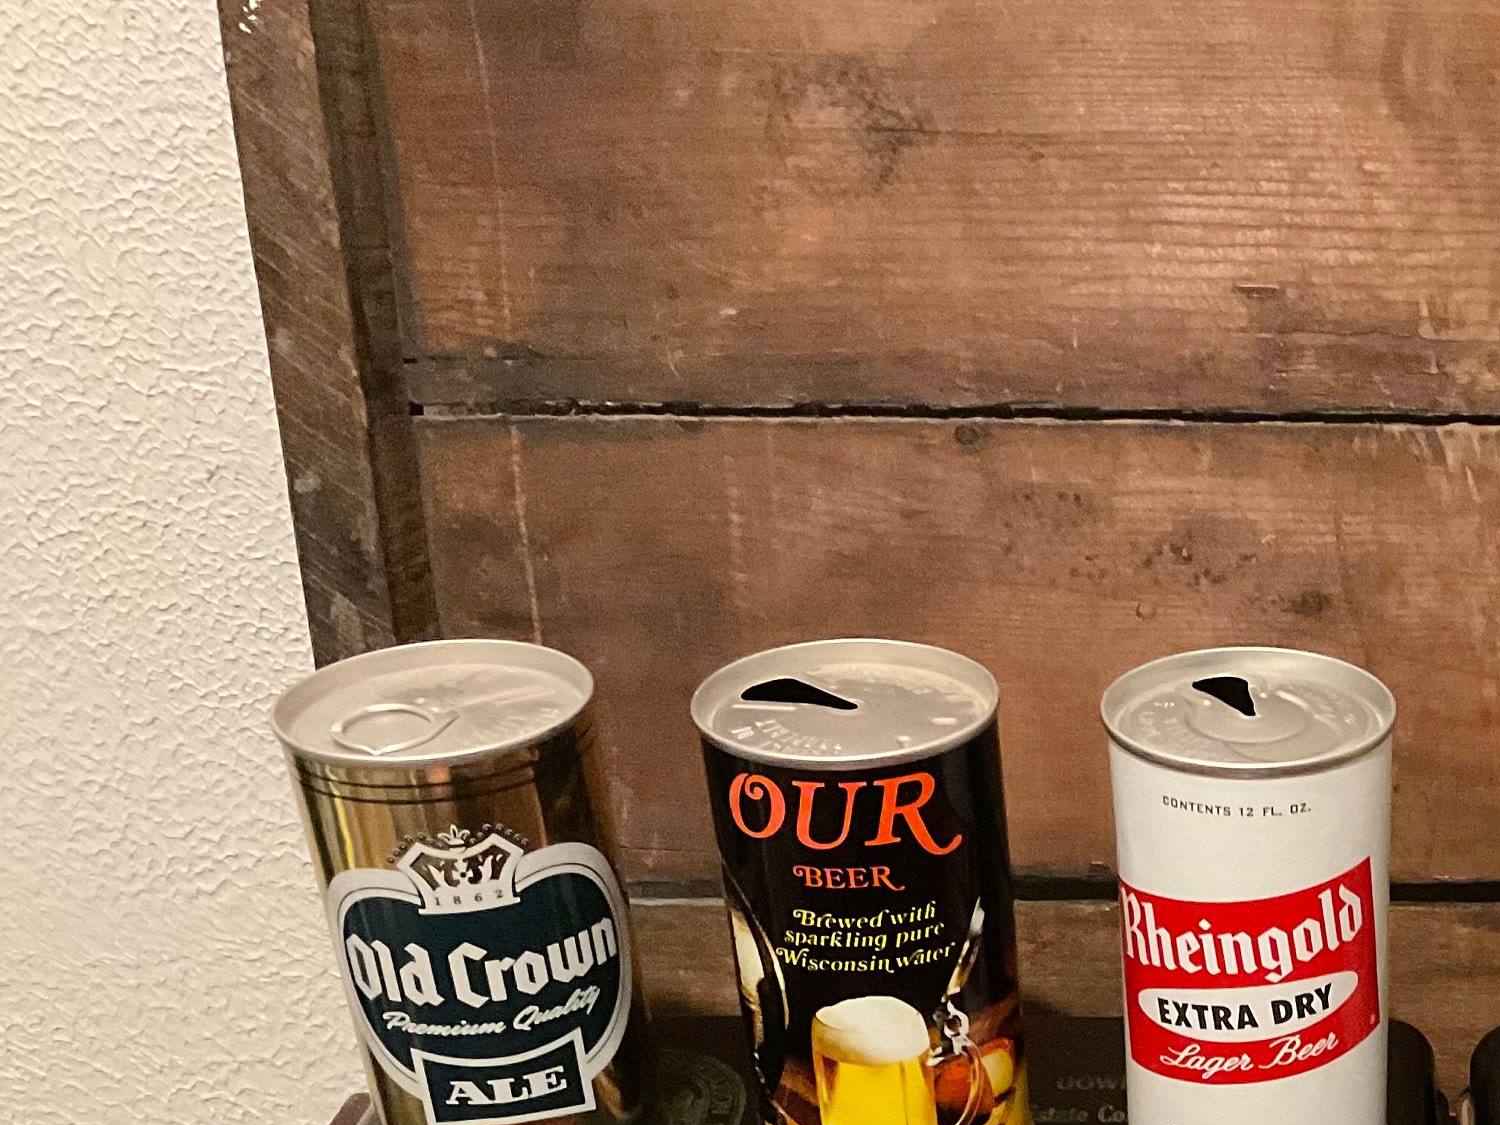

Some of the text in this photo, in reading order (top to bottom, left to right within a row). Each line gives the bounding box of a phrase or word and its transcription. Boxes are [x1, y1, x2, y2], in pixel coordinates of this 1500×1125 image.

[729, 772, 963, 855] OUR
[1162, 795, 1312, 818] CONTENTS 12 FL. OZ.
[792, 865, 906, 891] BEER
[792, 900, 936, 929] Brewed with
[1120, 883, 1363, 984] Rheingold
[776, 941, 956, 974] Wisconsin water
[784, 922, 945, 952] sparkling pure
[345, 917, 618, 1009] Old Crown
[382, 985, 600, 1037] Premium Quality
[1157, 983, 1332, 1030] EXTRA DRY
[1159, 1031, 1339, 1079] Lager Beer
[446, 1065, 568, 1106] ALE
